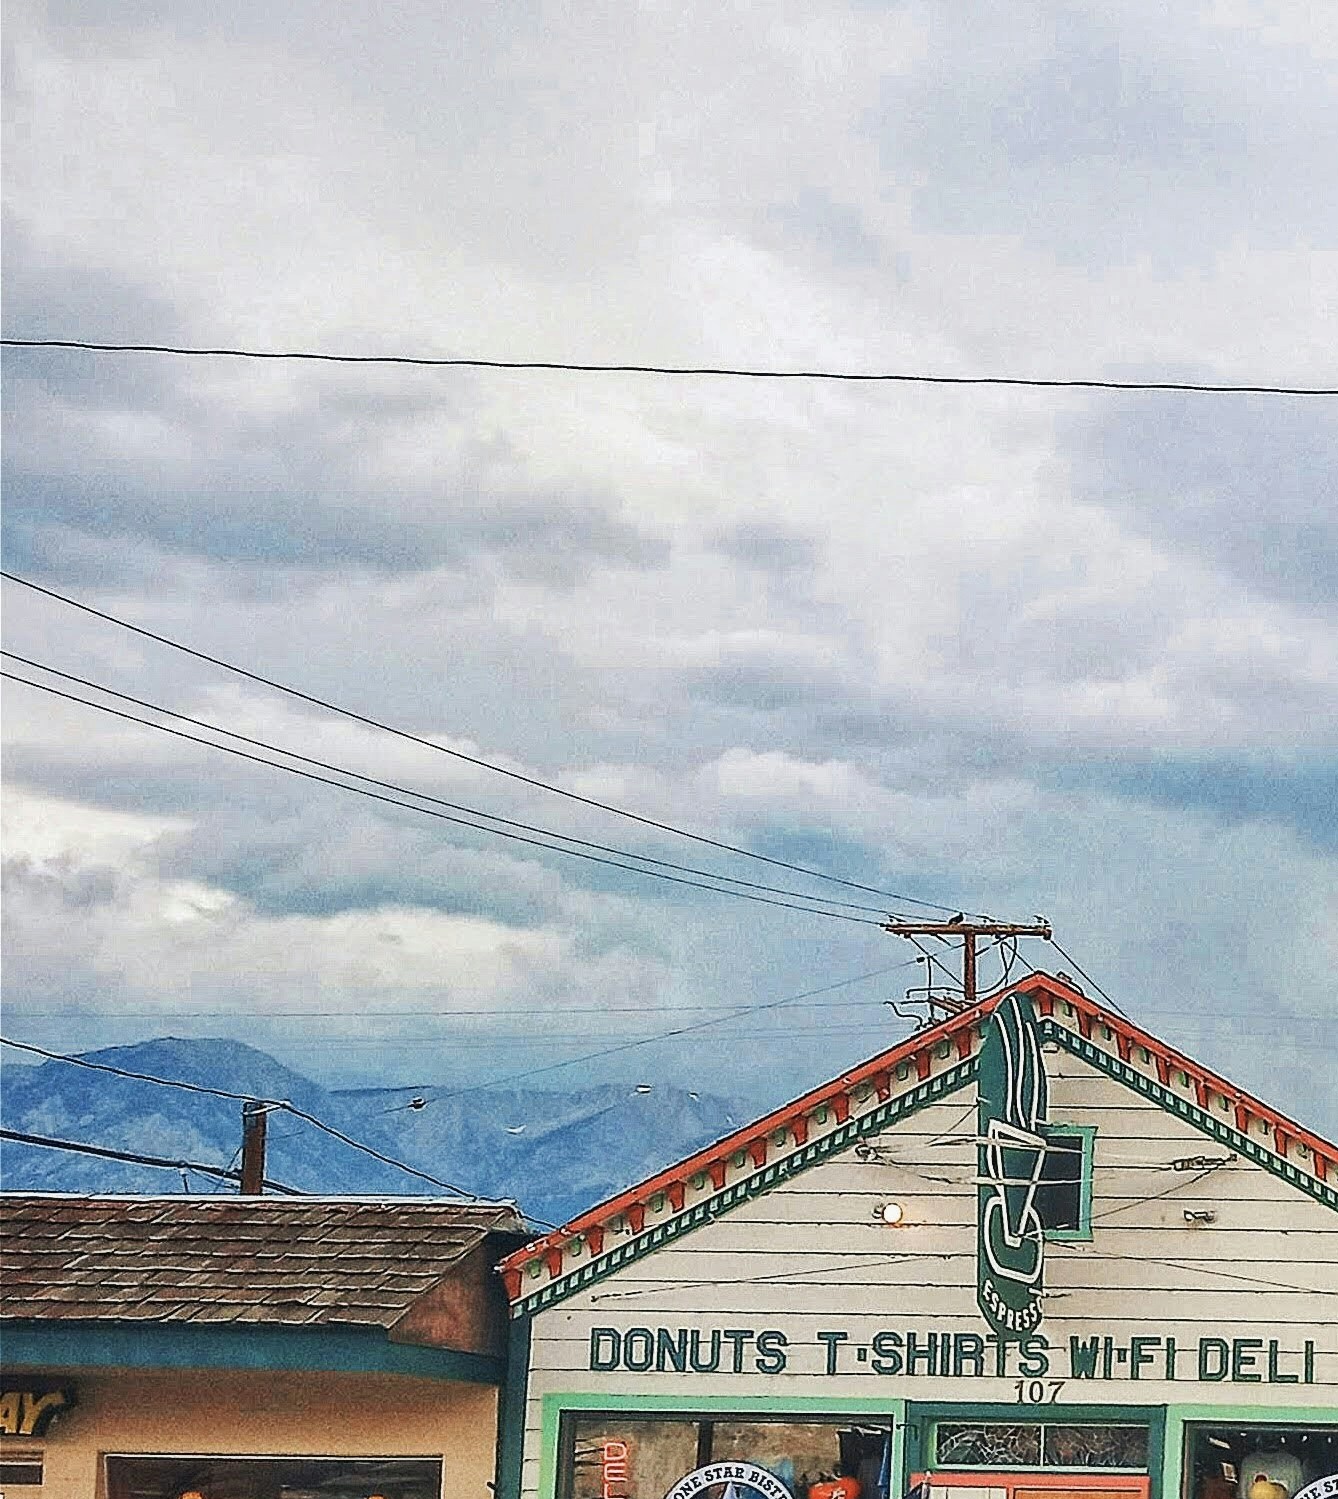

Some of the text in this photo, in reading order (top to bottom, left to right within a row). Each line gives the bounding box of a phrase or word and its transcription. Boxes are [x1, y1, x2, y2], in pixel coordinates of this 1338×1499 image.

[589, 1327, 789, 1374] DONUTS
[1199, 1337, 1314, 1384] DELI
[1014, 1381, 1066, 1404] 107
[704, 1466, 745, 1482] STAR
